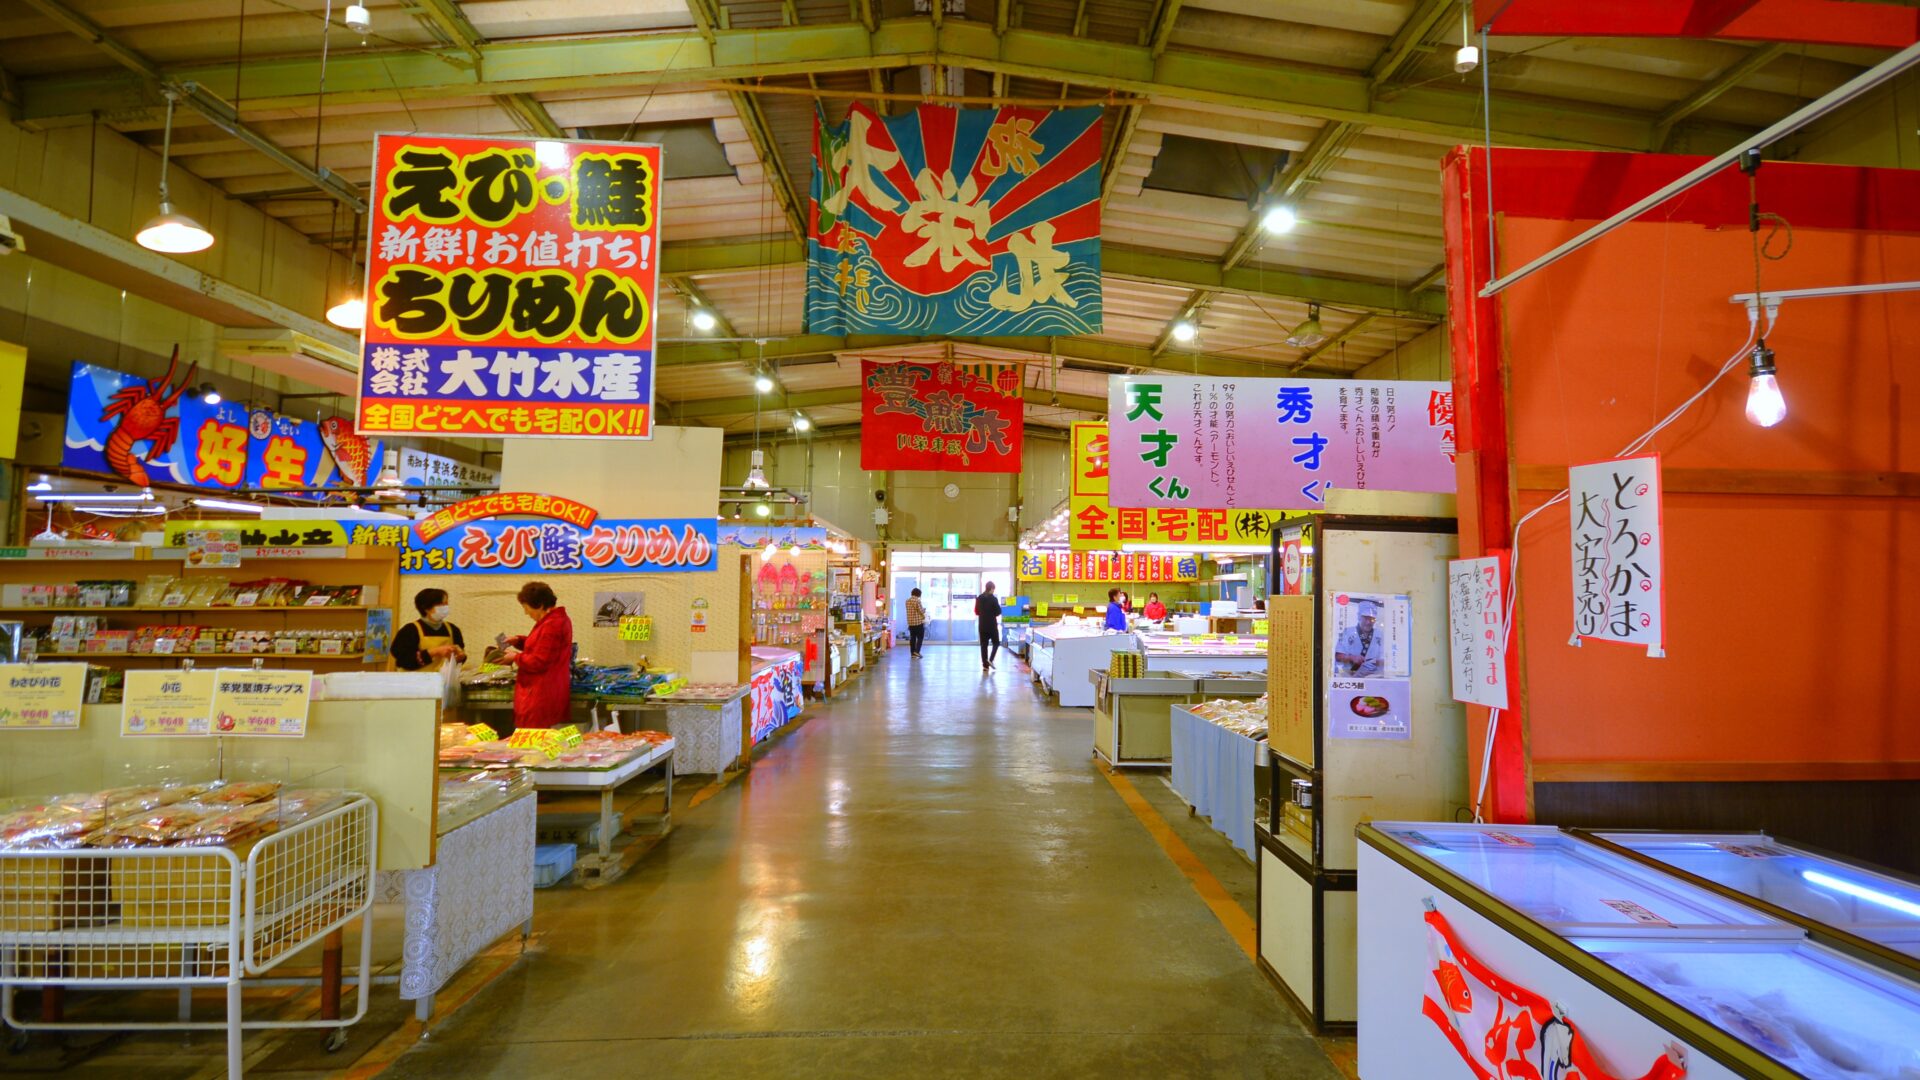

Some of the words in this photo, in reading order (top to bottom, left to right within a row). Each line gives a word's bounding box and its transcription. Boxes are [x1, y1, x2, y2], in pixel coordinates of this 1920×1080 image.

[384, 146, 651, 229] えび・鮭
[376, 267, 648, 341] ちりめん
[437, 350, 643, 401] 大竹水産
[363, 402, 645, 435] 全国どこへでも宅配OK!!
[418, 493, 592, 541] 全国どこでも宅配OK!!
[1021, 554, 1043, 576] 活
[1177, 557, 1198, 578] 魚
[1575, 490, 1606, 636] 大安売り
[1609, 471, 1652, 637] とろかま
